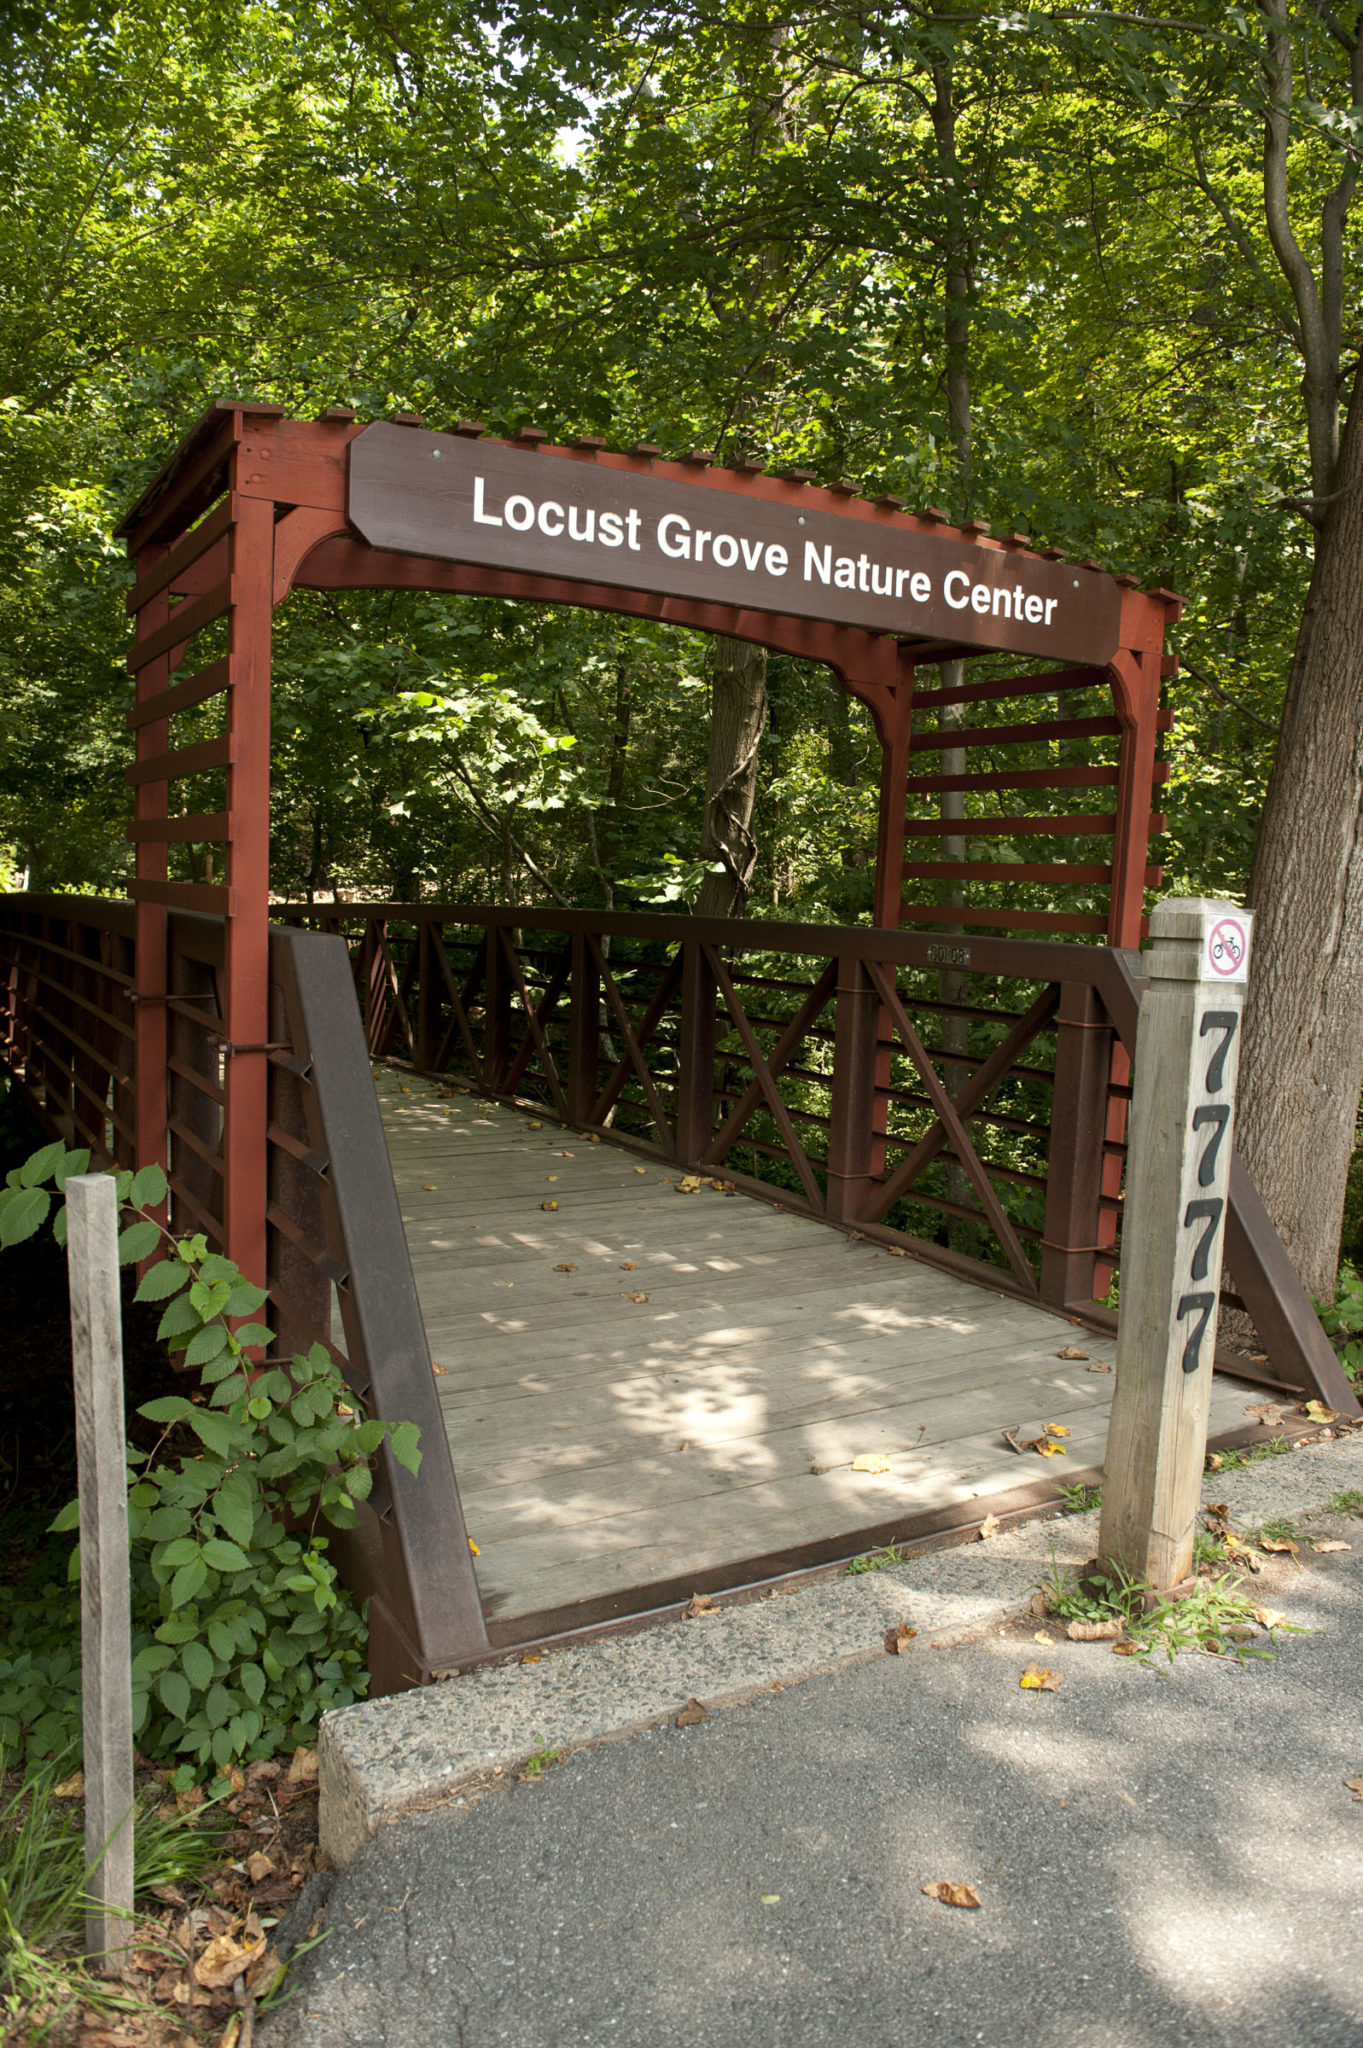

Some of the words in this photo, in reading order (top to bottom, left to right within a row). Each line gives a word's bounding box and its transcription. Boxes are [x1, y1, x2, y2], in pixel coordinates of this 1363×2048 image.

[473, 476, 642, 551] Locust
[657, 513, 789, 577] Grove
[803, 540, 932, 603] Nature
[943, 570, 1059, 626] Center
[1176, 1010, 1238, 1374] 7777
